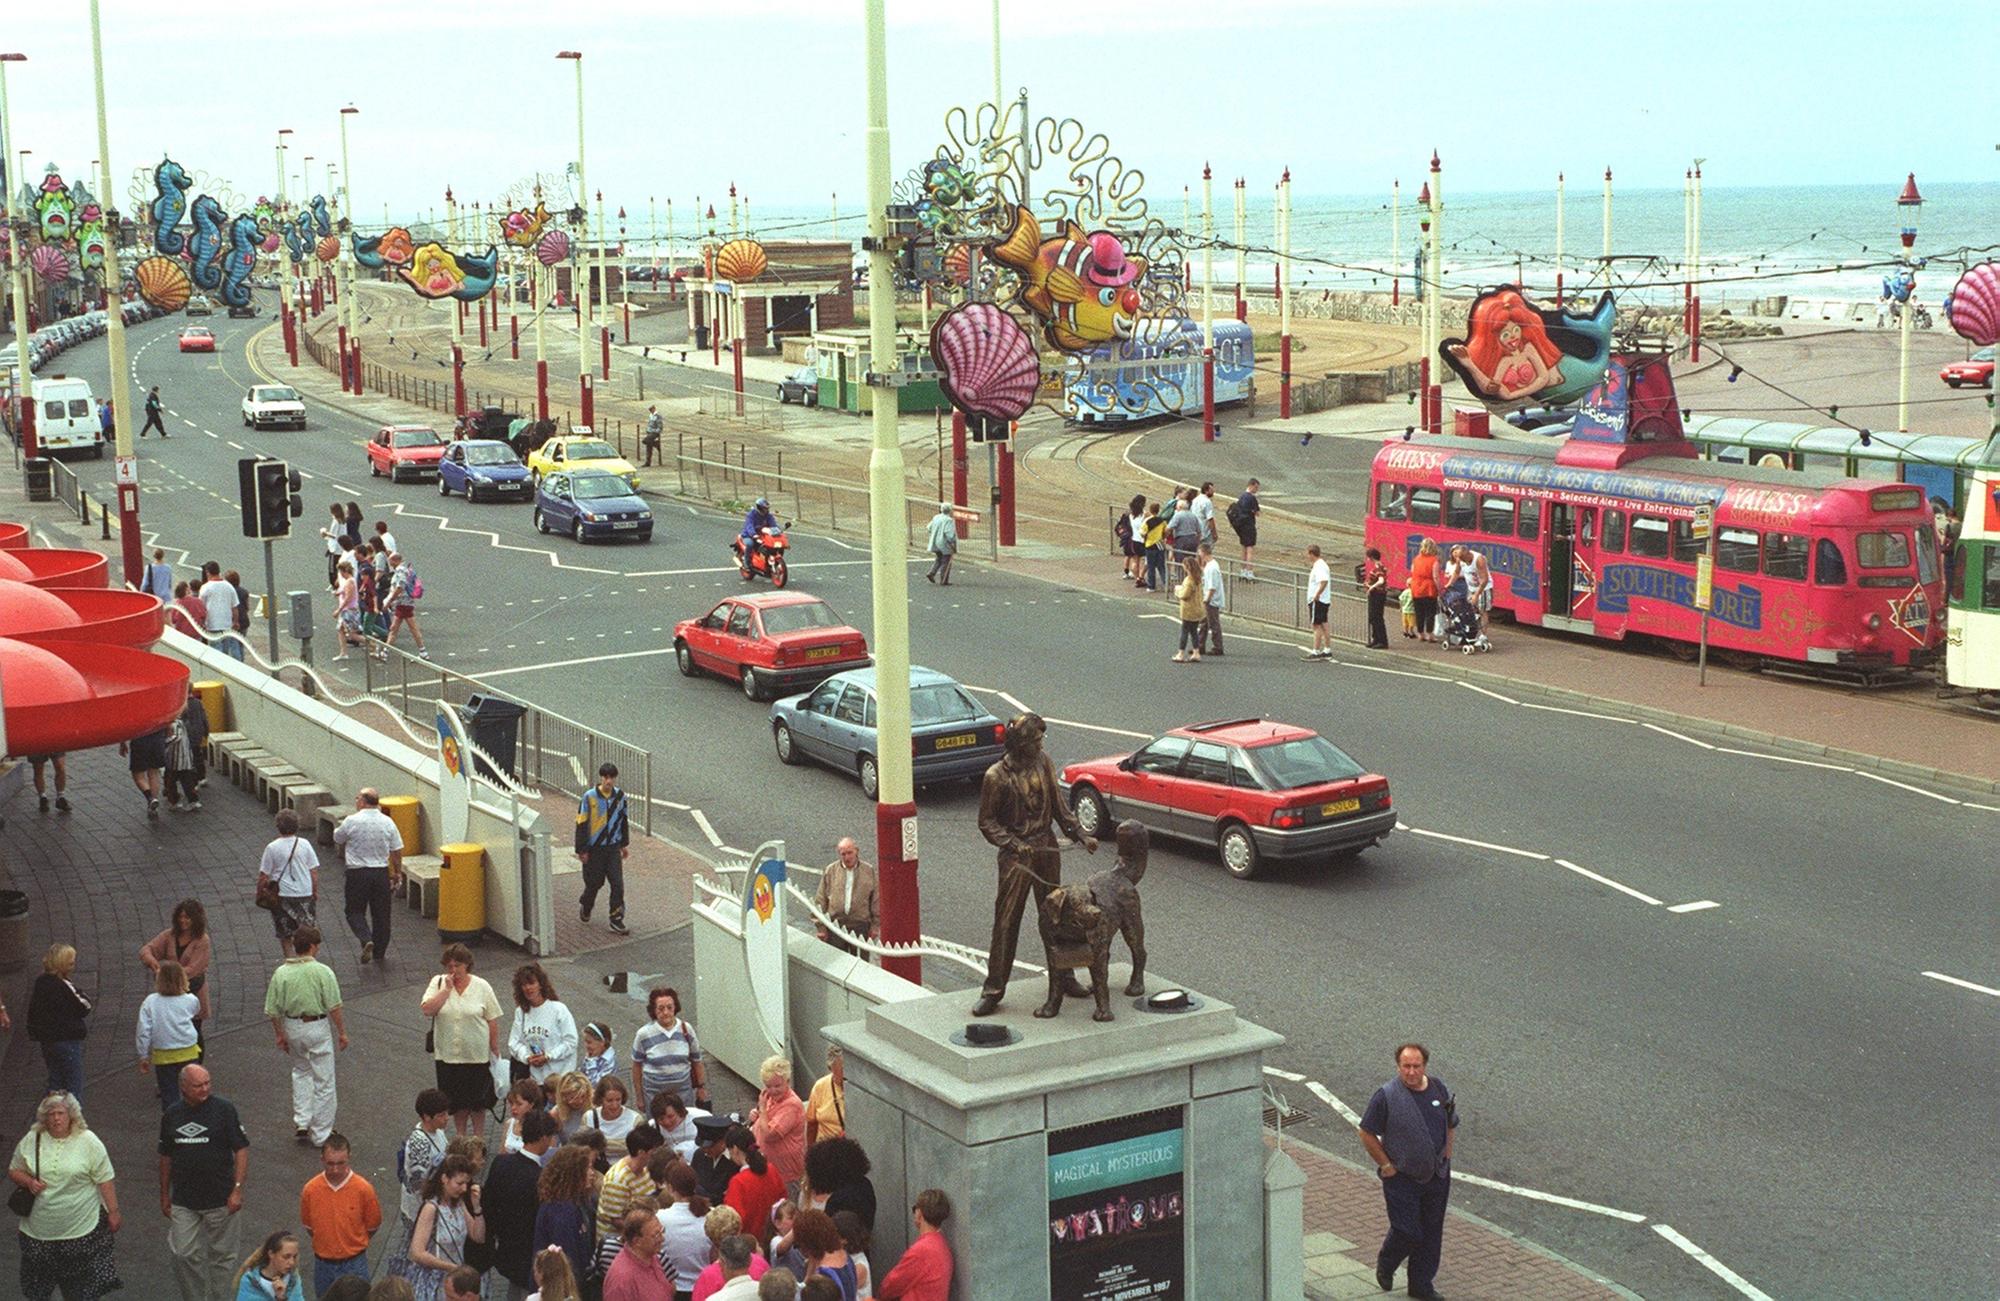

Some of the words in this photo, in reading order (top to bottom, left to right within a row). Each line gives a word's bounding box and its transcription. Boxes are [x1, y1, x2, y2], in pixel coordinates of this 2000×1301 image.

[121, 463, 129, 477] 4
[1470, 461, 1515, 480] GOLDEN
[1553, 471, 1589, 489] MOST
[1592, 475, 1658, 499] GLITTERING
[1443, 478, 1470, 491] Quality
[1471, 481, 1493, 492] Foods
[1498, 484, 1519, 496] Wines
[1527, 489, 1553, 500] Spirits
[1560, 492, 1598, 505] Selected
[1600, 497, 1618, 508] Ales
[1624, 501, 1642, 511] Live
[1643, 503, 1696, 518] Entertainm
[1732, 487, 1804, 515] YATES'S
[1609, 567, 1677, 599] SOUTH
[1685, 583, 1754, 626] SORE
[1054, 1161, 1103, 1184] MAGICAL
[1107, 1145, 1174, 1173] MYSTERIOUS
[1050, 1192, 1182, 1241] MYSTIQUE
[1114, 1285, 1151, 1301] NOVEMBER
